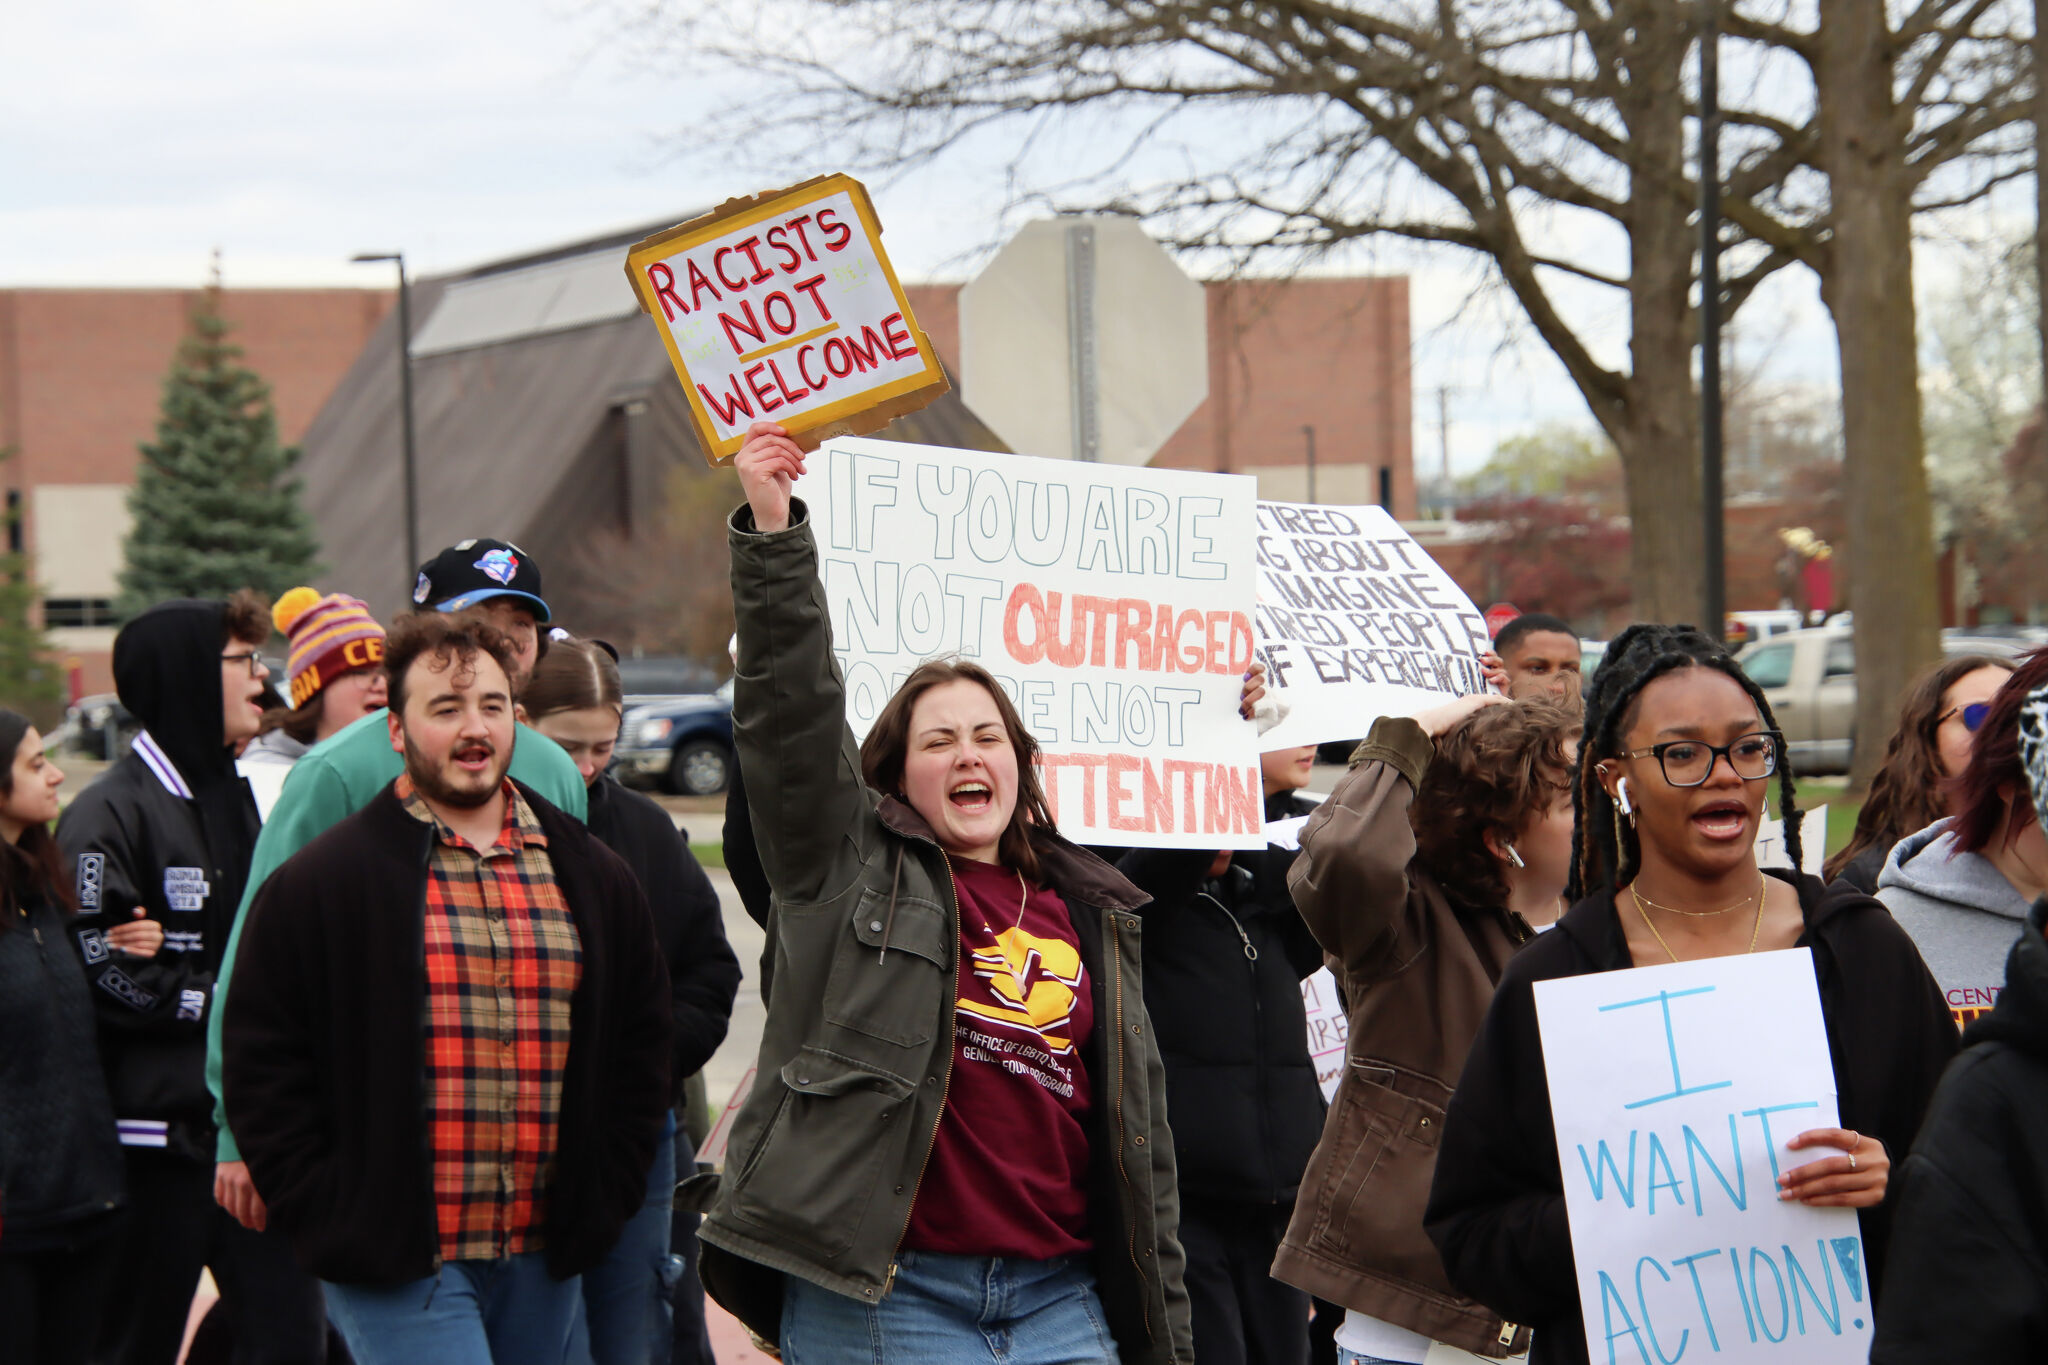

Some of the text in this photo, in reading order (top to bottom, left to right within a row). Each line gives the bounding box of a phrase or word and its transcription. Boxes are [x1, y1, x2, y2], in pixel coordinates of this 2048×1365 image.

[648, 208, 851, 323] RACISTS
[717, 273, 832, 356] NOT
[697, 312, 918, 427] WELCOME
[829, 449, 1227, 580] IF YOU ARE
[1290, 538, 1418, 573] ABOUT
[825, 559, 1254, 675] NOT OUTRAGED
[1263, 571, 1459, 611] IMAGINE
[343, 637, 384, 667] CE
[1303, 645, 1488, 699] EXPERIENCIN
[1346, 611, 1488, 660] PEOPLE
[1072, 682, 1201, 746] NOT
[1026, 752, 1261, 835] TTENTION
[1946, 986, 2003, 1006] CENT
[969, 1030, 1006, 1052] OFFICE
[1003, 1041, 1020, 1053] OF
[1017, 1044, 1049, 1066] LGBTQ
[1598, 984, 1733, 1110] I
[1577, 1101, 1819, 1217] WANT
[1597, 1236, 1864, 1365] ACTION!
